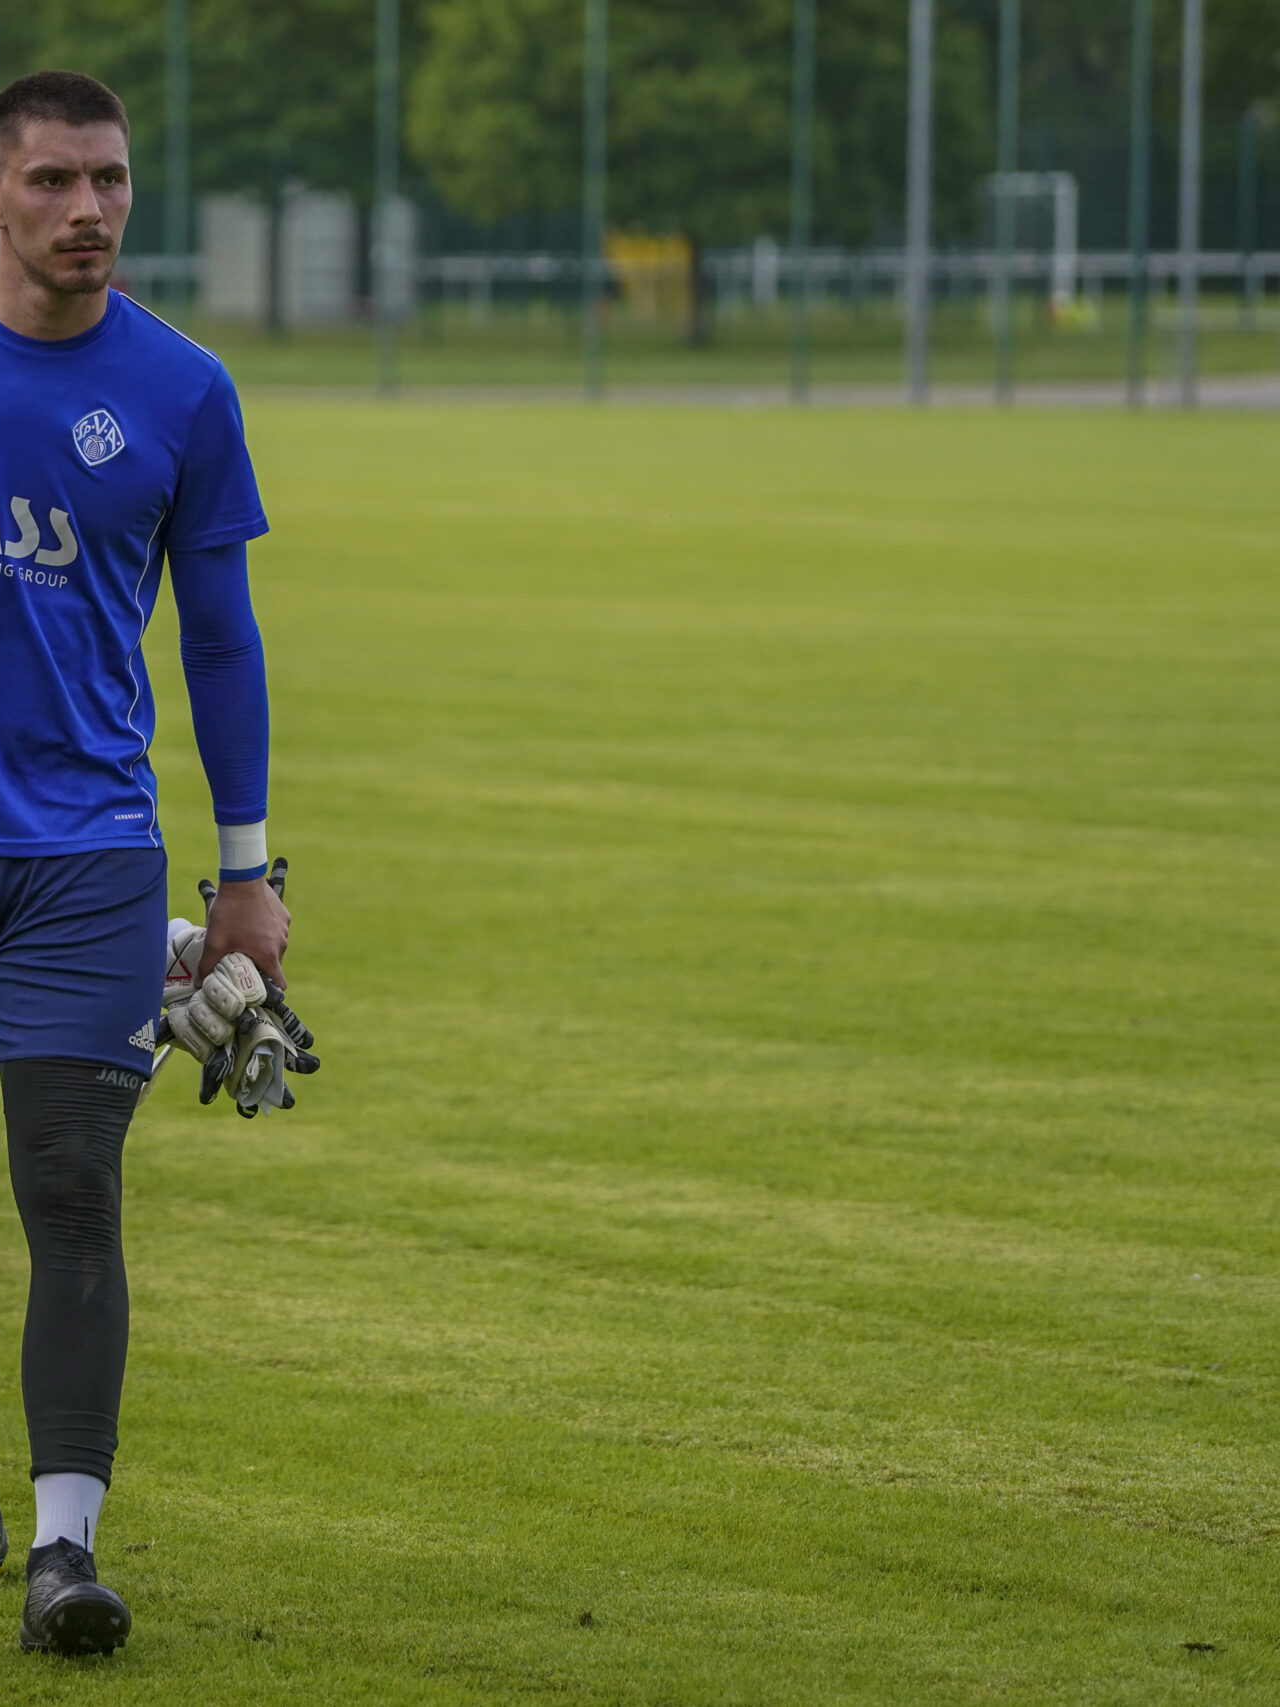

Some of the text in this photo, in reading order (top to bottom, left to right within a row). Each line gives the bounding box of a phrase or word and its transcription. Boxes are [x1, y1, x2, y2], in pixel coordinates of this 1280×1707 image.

[18, 567, 69, 589] GROUP
[128, 1035, 156, 1053] adida
[96, 1067, 140, 1090] JAKO
